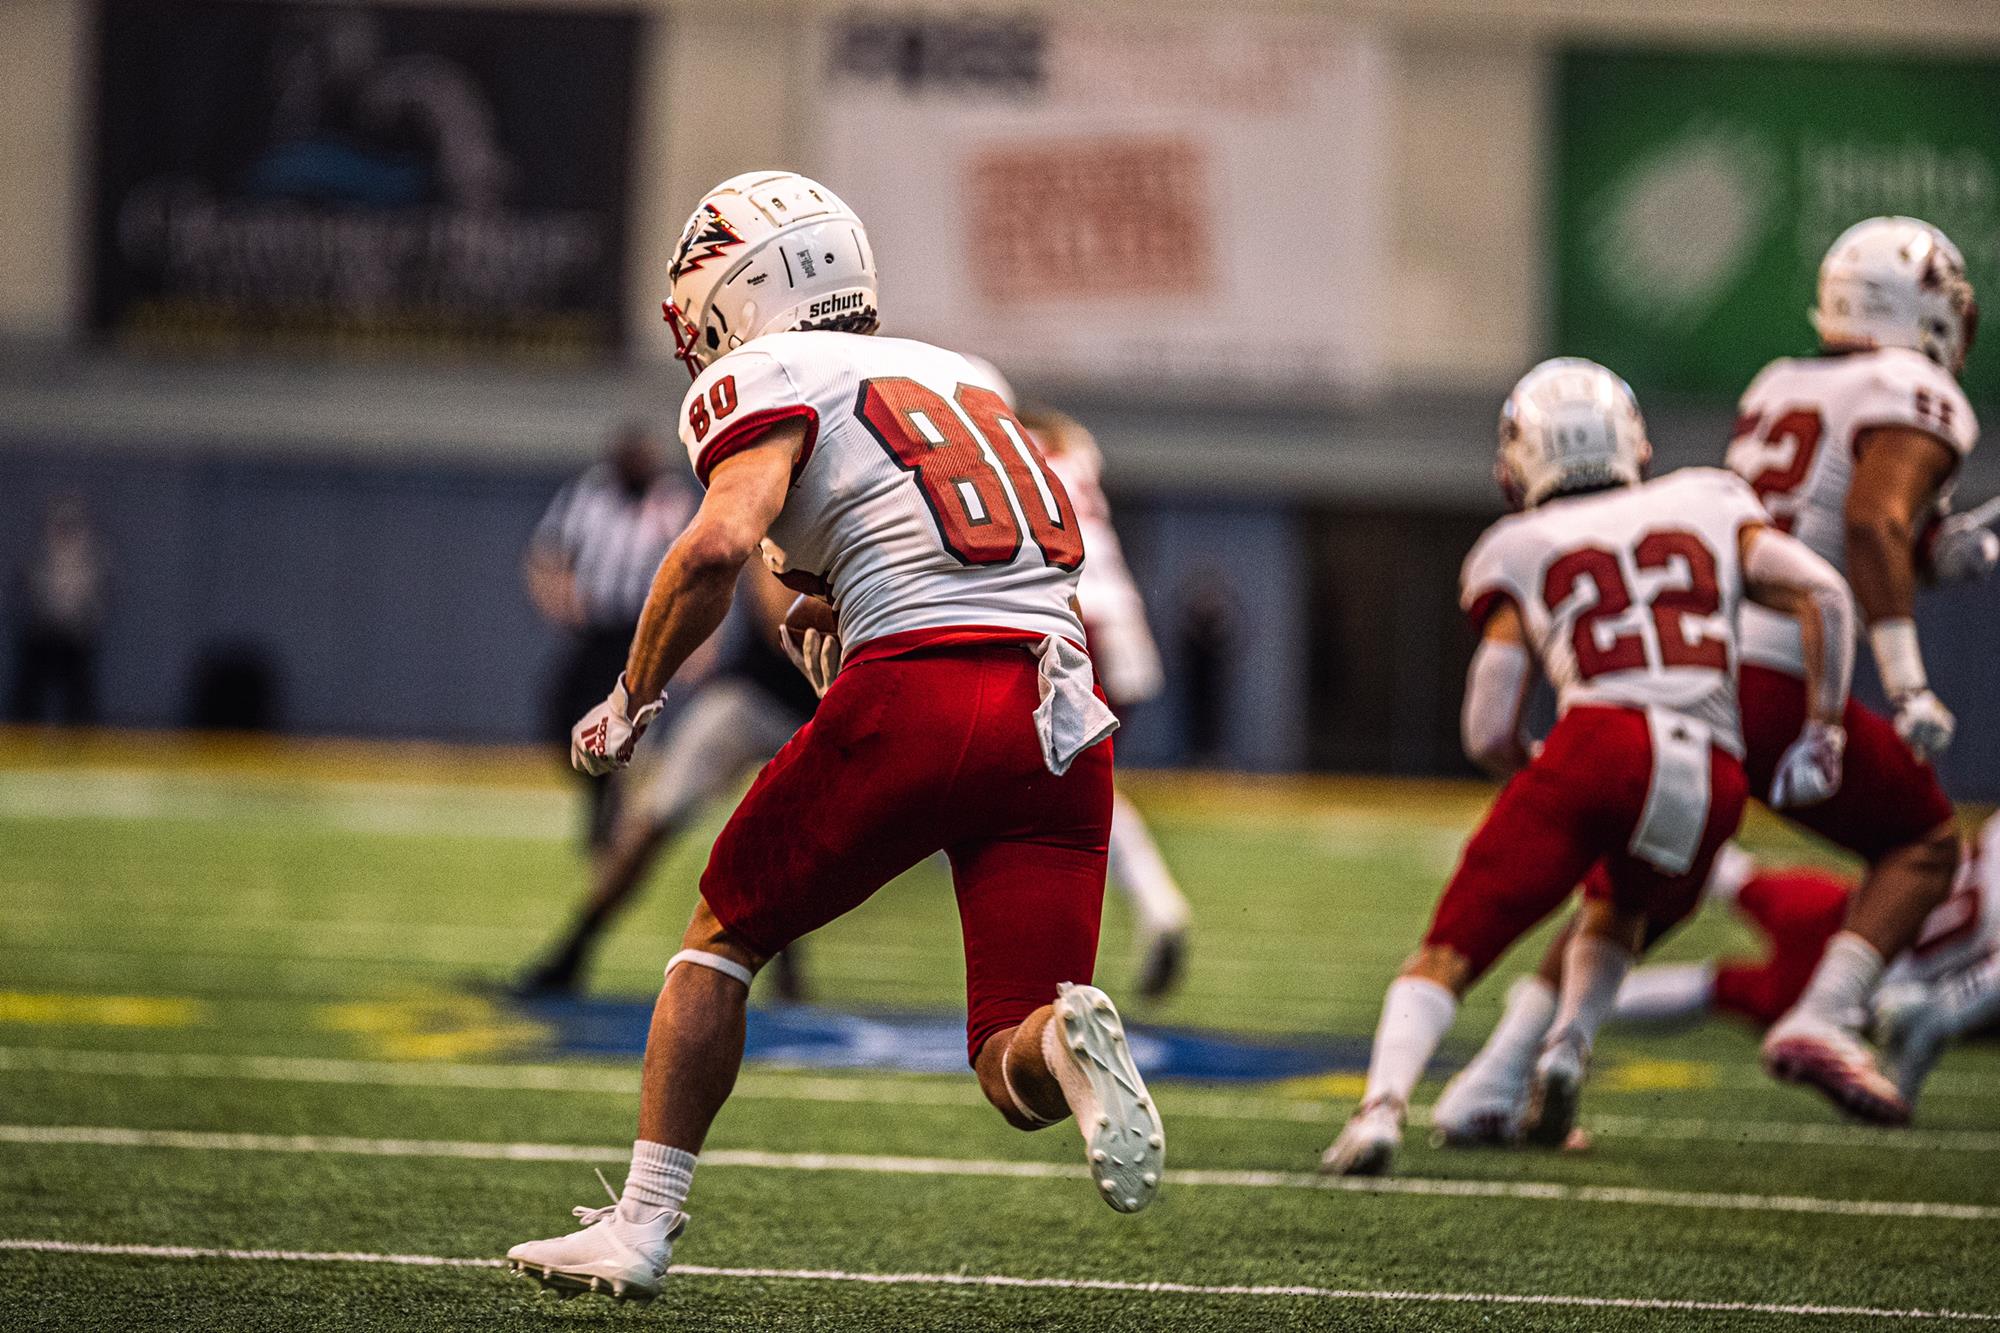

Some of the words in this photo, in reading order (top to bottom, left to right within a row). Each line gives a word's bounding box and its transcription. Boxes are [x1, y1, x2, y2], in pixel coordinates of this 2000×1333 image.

[809, 291, 864, 318] schutt
[689, 374, 738, 443] 80
[853, 376, 1085, 574] 80
[1544, 530, 1728, 681] 22
